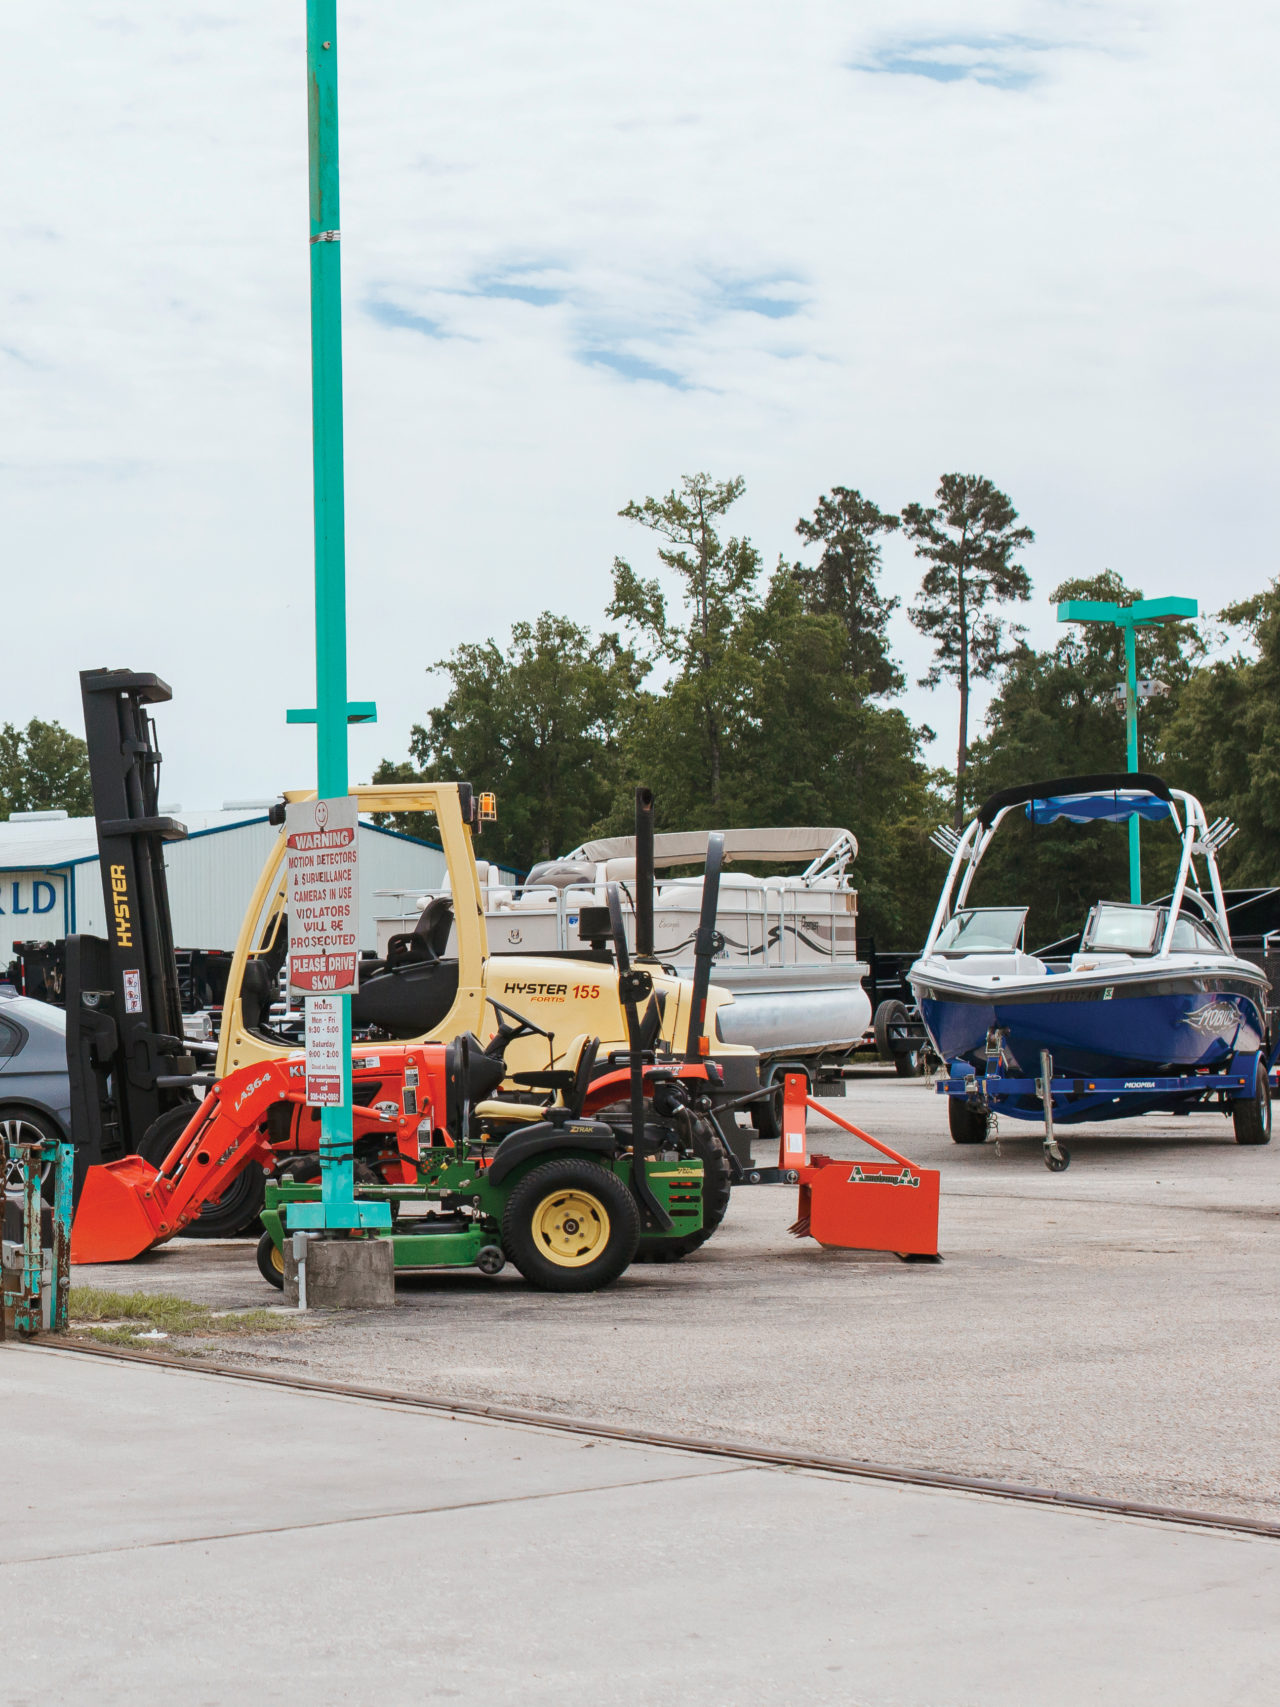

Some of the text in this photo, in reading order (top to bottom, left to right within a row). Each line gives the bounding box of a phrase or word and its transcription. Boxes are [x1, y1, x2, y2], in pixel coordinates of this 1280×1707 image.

[295, 831, 350, 850] WARNING
[288, 850, 357, 869] MOTION DETECTORS
[294, 869, 352, 886] & SURVEILLANCE
[294, 886, 352, 902] CAMERAS IN USE
[110, 864, 133, 947] HYSTER
[296, 905, 350, 919] VIOLATORS
[304, 919, 343, 932] WILL BE
[290, 934, 356, 949] PROSECUTED
[292, 954, 355, 974] PLEASE DRIVE
[311, 975, 337, 991] SLOW
[504, 982, 600, 999] HYSTER 155
[314, 1002, 333, 1011] Hours
[328, 1016, 336, 1024] Fri
[312, 1040, 336, 1048] Saturday
[308, 1050, 320, 1058] 9:00
[234, 1072, 272, 1112] LA364
